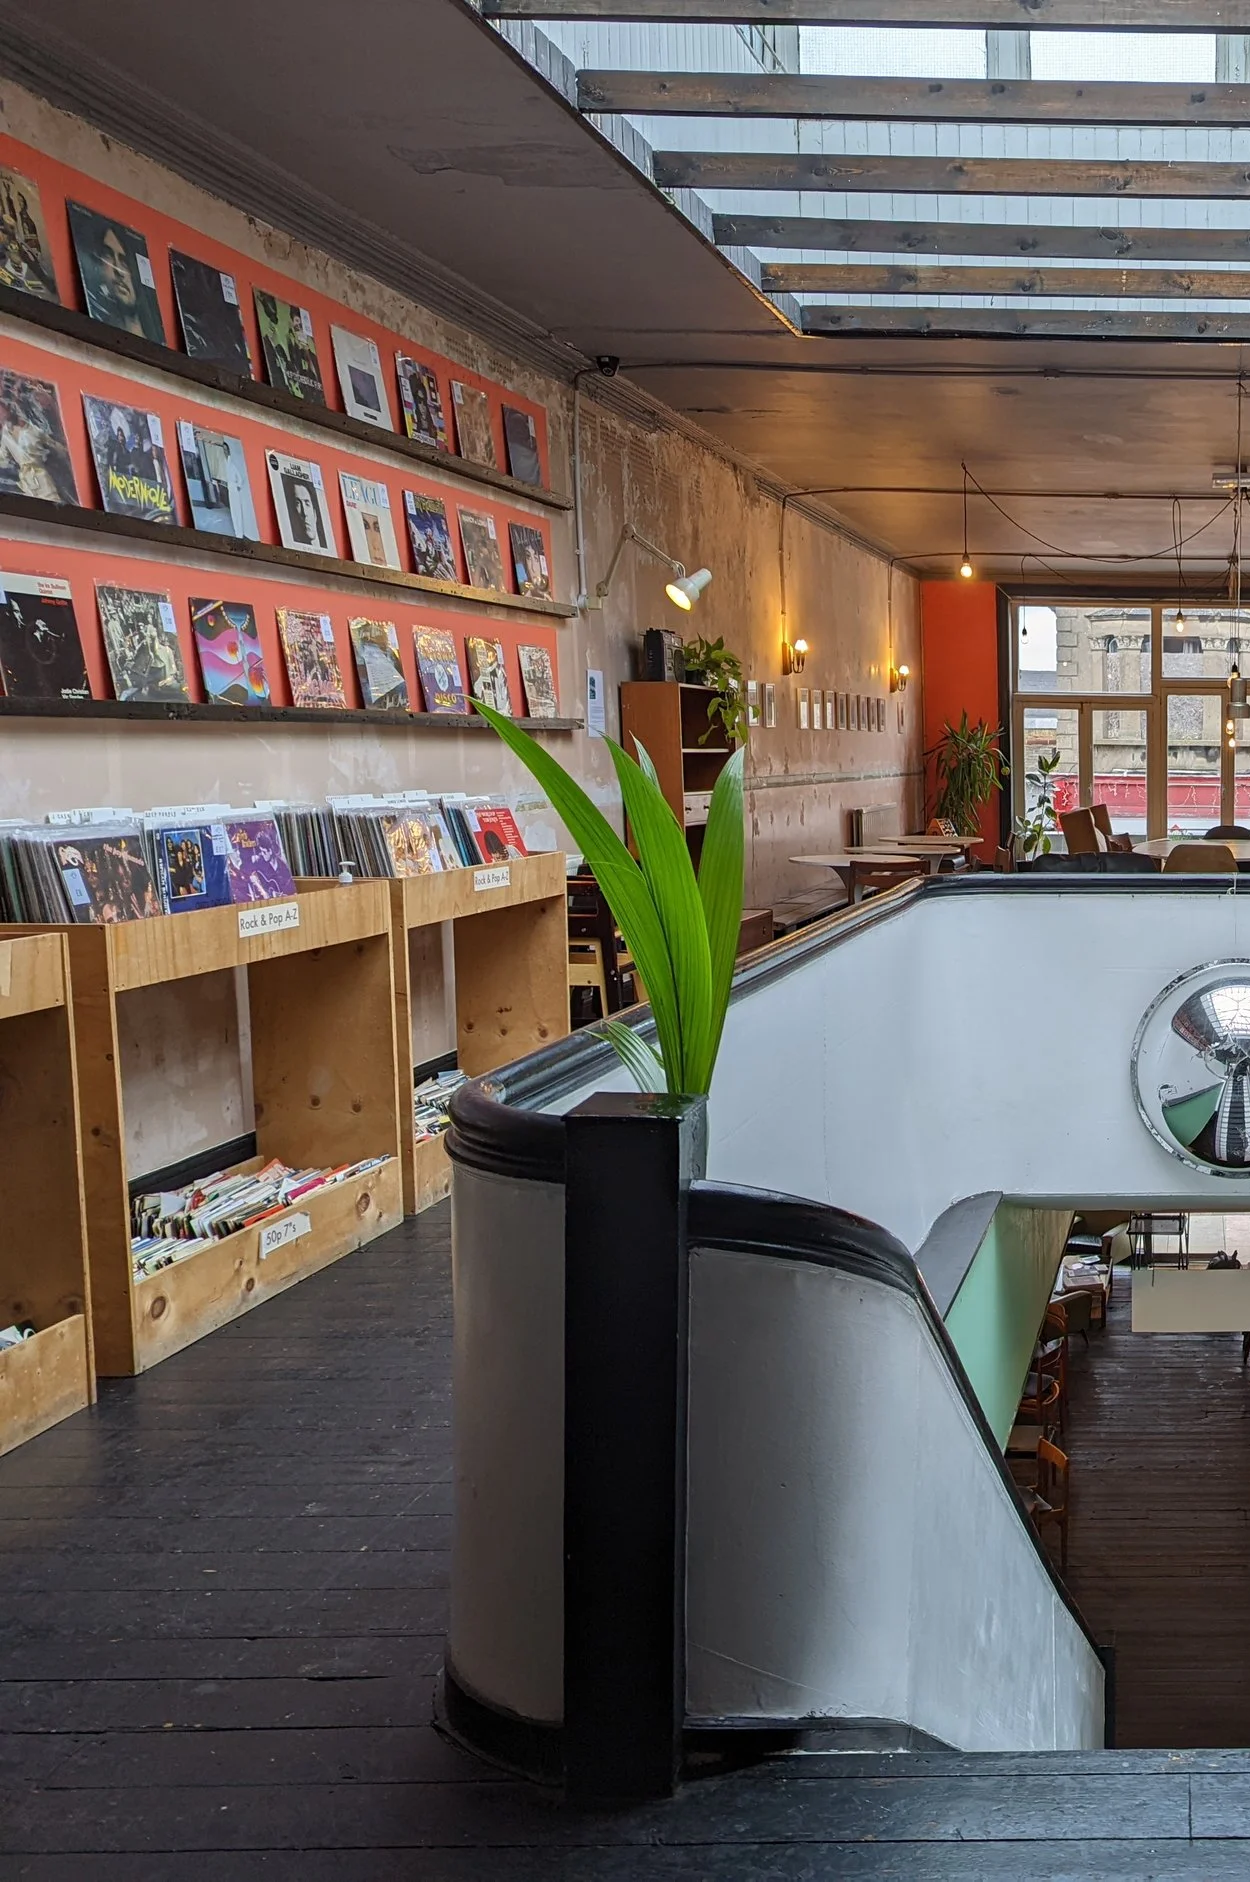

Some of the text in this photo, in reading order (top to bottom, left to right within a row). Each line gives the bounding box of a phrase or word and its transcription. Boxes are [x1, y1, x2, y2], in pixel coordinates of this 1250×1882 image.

[283, 467, 310, 481] GALLAGHER
[475, 875, 486, 886] Rock
[492, 873, 501, 885] Pop
[501, 871, 509, 882] A-Z
[240, 908, 298, 931] Rock & Pop A-Z
[266, 1230, 282, 1245] 50p
